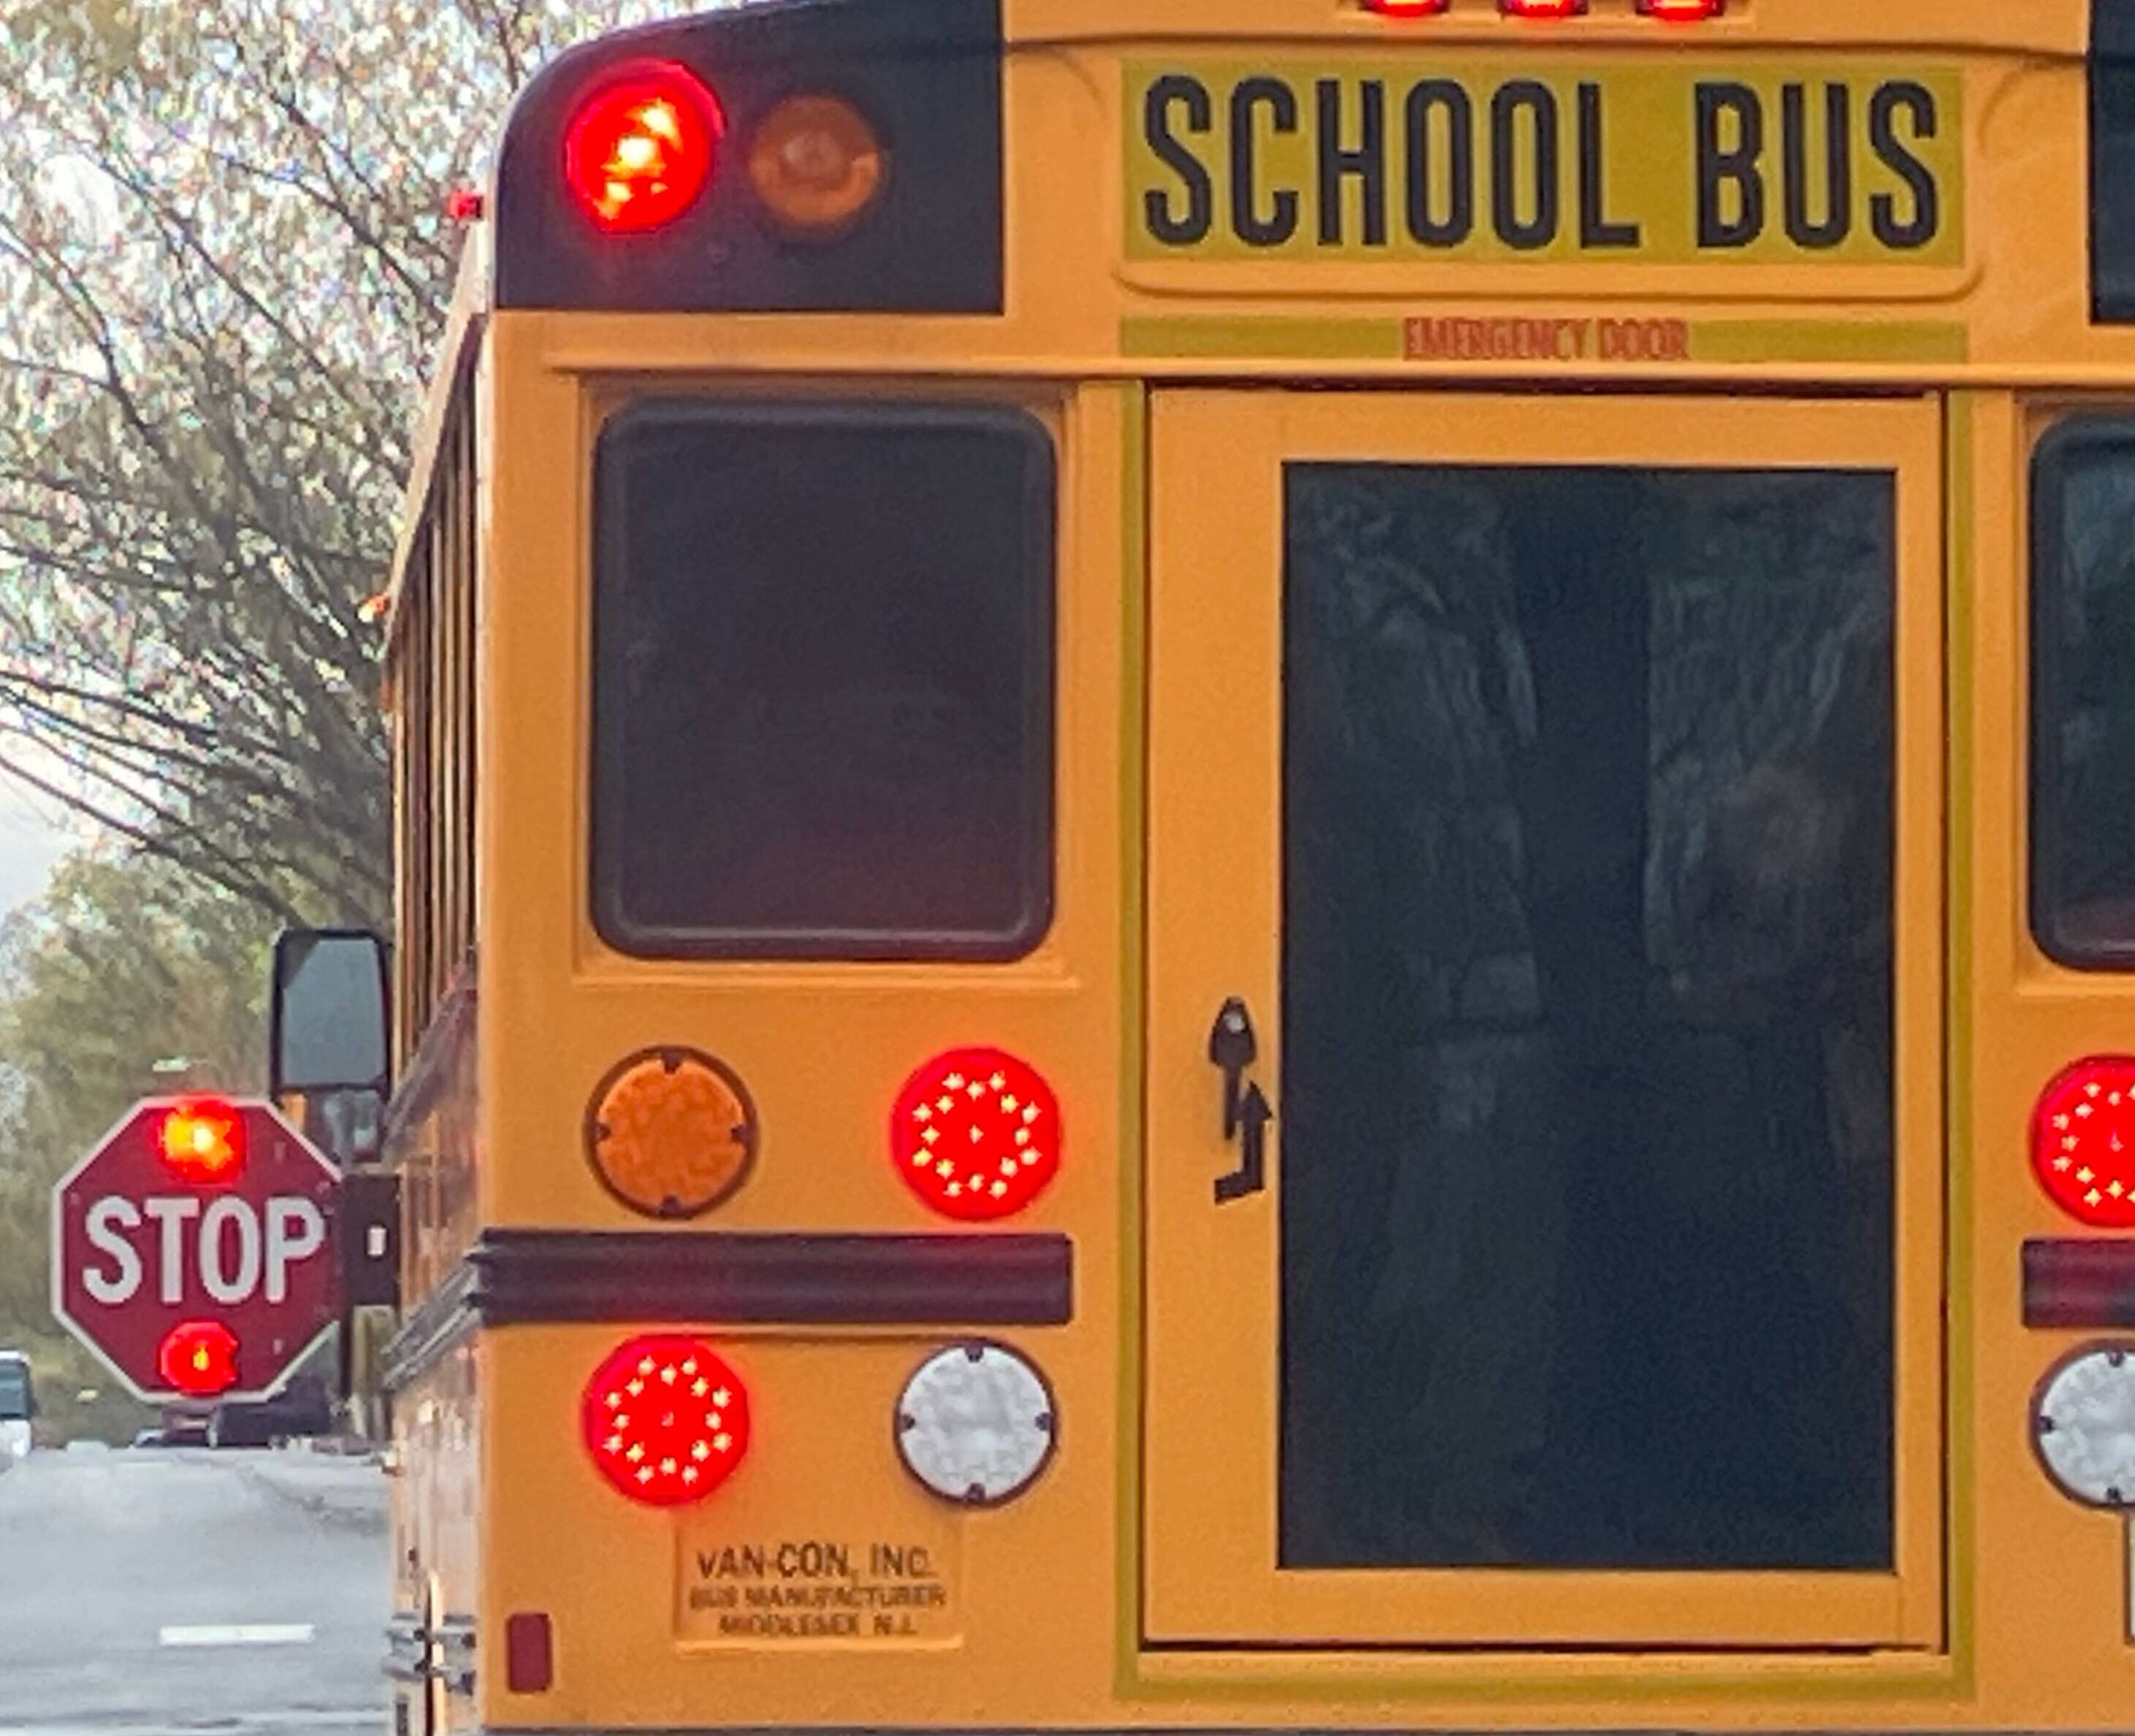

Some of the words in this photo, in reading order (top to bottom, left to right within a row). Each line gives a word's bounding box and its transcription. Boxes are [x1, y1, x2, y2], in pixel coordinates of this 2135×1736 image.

[1145, 74, 1641, 250] SCHOOL
[1696, 80, 1939, 251] BUS
[1402, 317, 1591, 361] EMERGENCY
[1597, 317, 1692, 361] DOOR
[83, 1196, 325, 1304] STOP
[745, 1585, 947, 1607] MANUFACTURER
